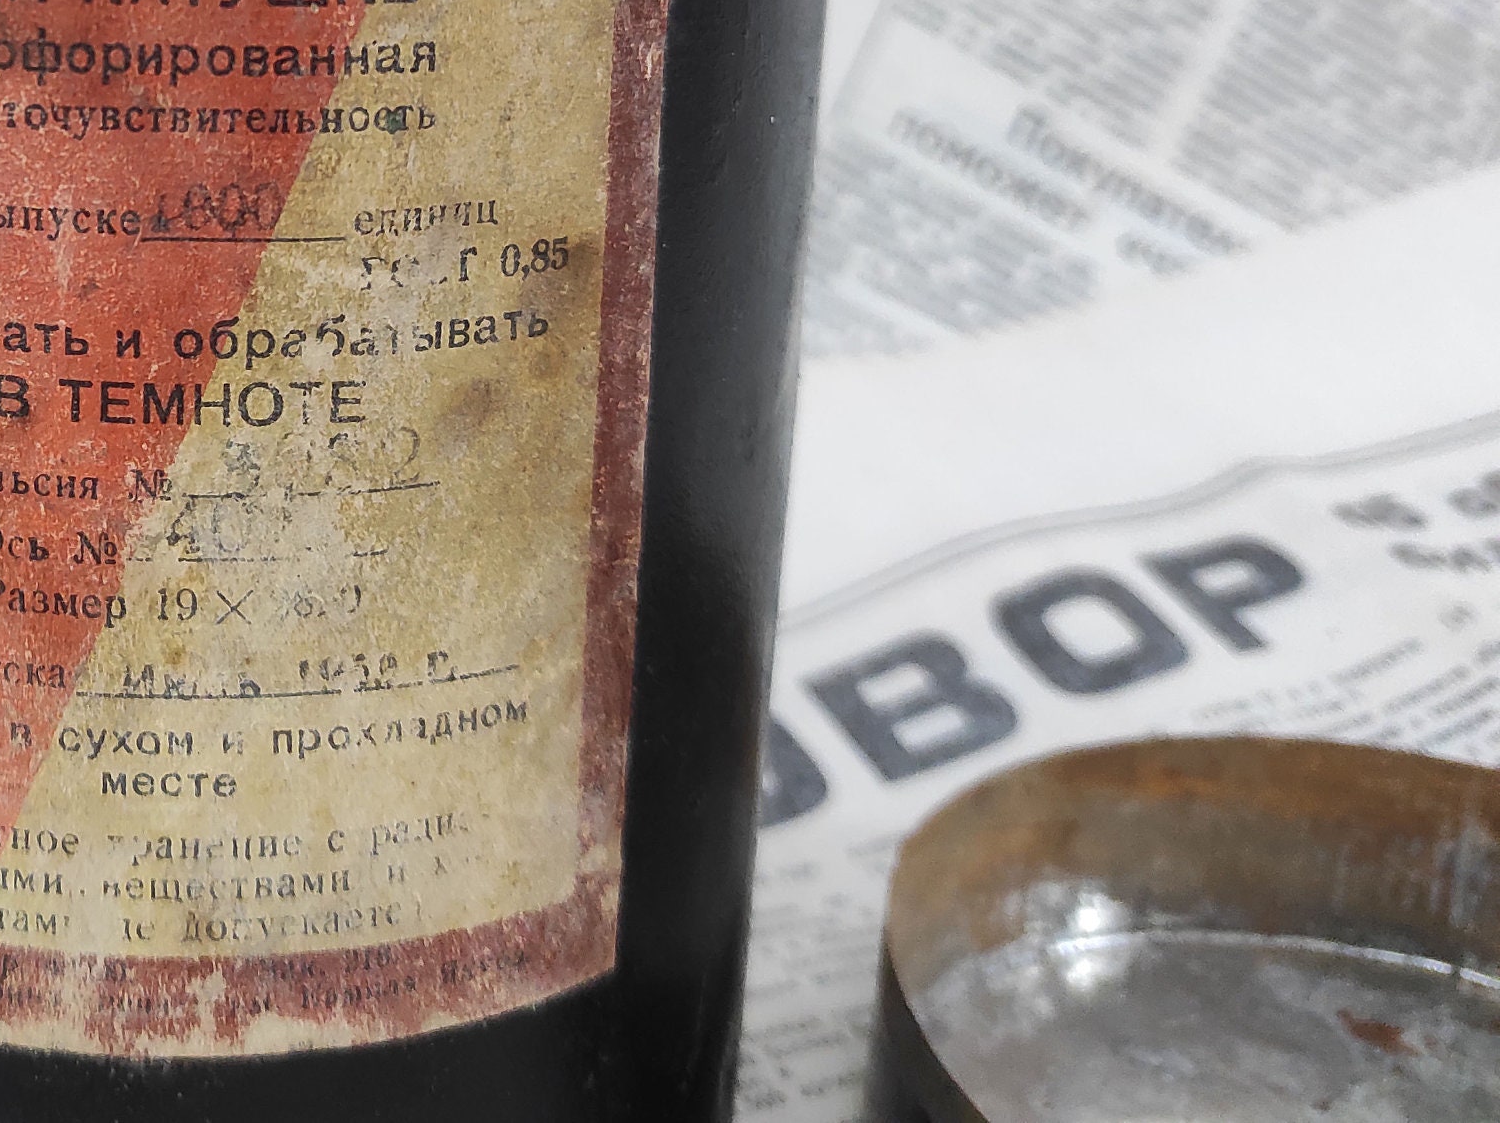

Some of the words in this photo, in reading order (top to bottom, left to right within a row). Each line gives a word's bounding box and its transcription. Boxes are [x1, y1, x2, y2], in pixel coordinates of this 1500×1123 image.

[500, 236, 569, 279] 0,85
[115, 332, 141, 359] и
[174, 308, 549, 369] обрабатывать
[59, 378, 367, 427] ТЕМНОТЕ
[157, 586, 198, 621] 19
[58, 725, 194, 760] сухом
[272, 697, 529, 760] прохладном
[100, 771, 238, 798] месте
[181, 902, 425, 944] допускаетс
